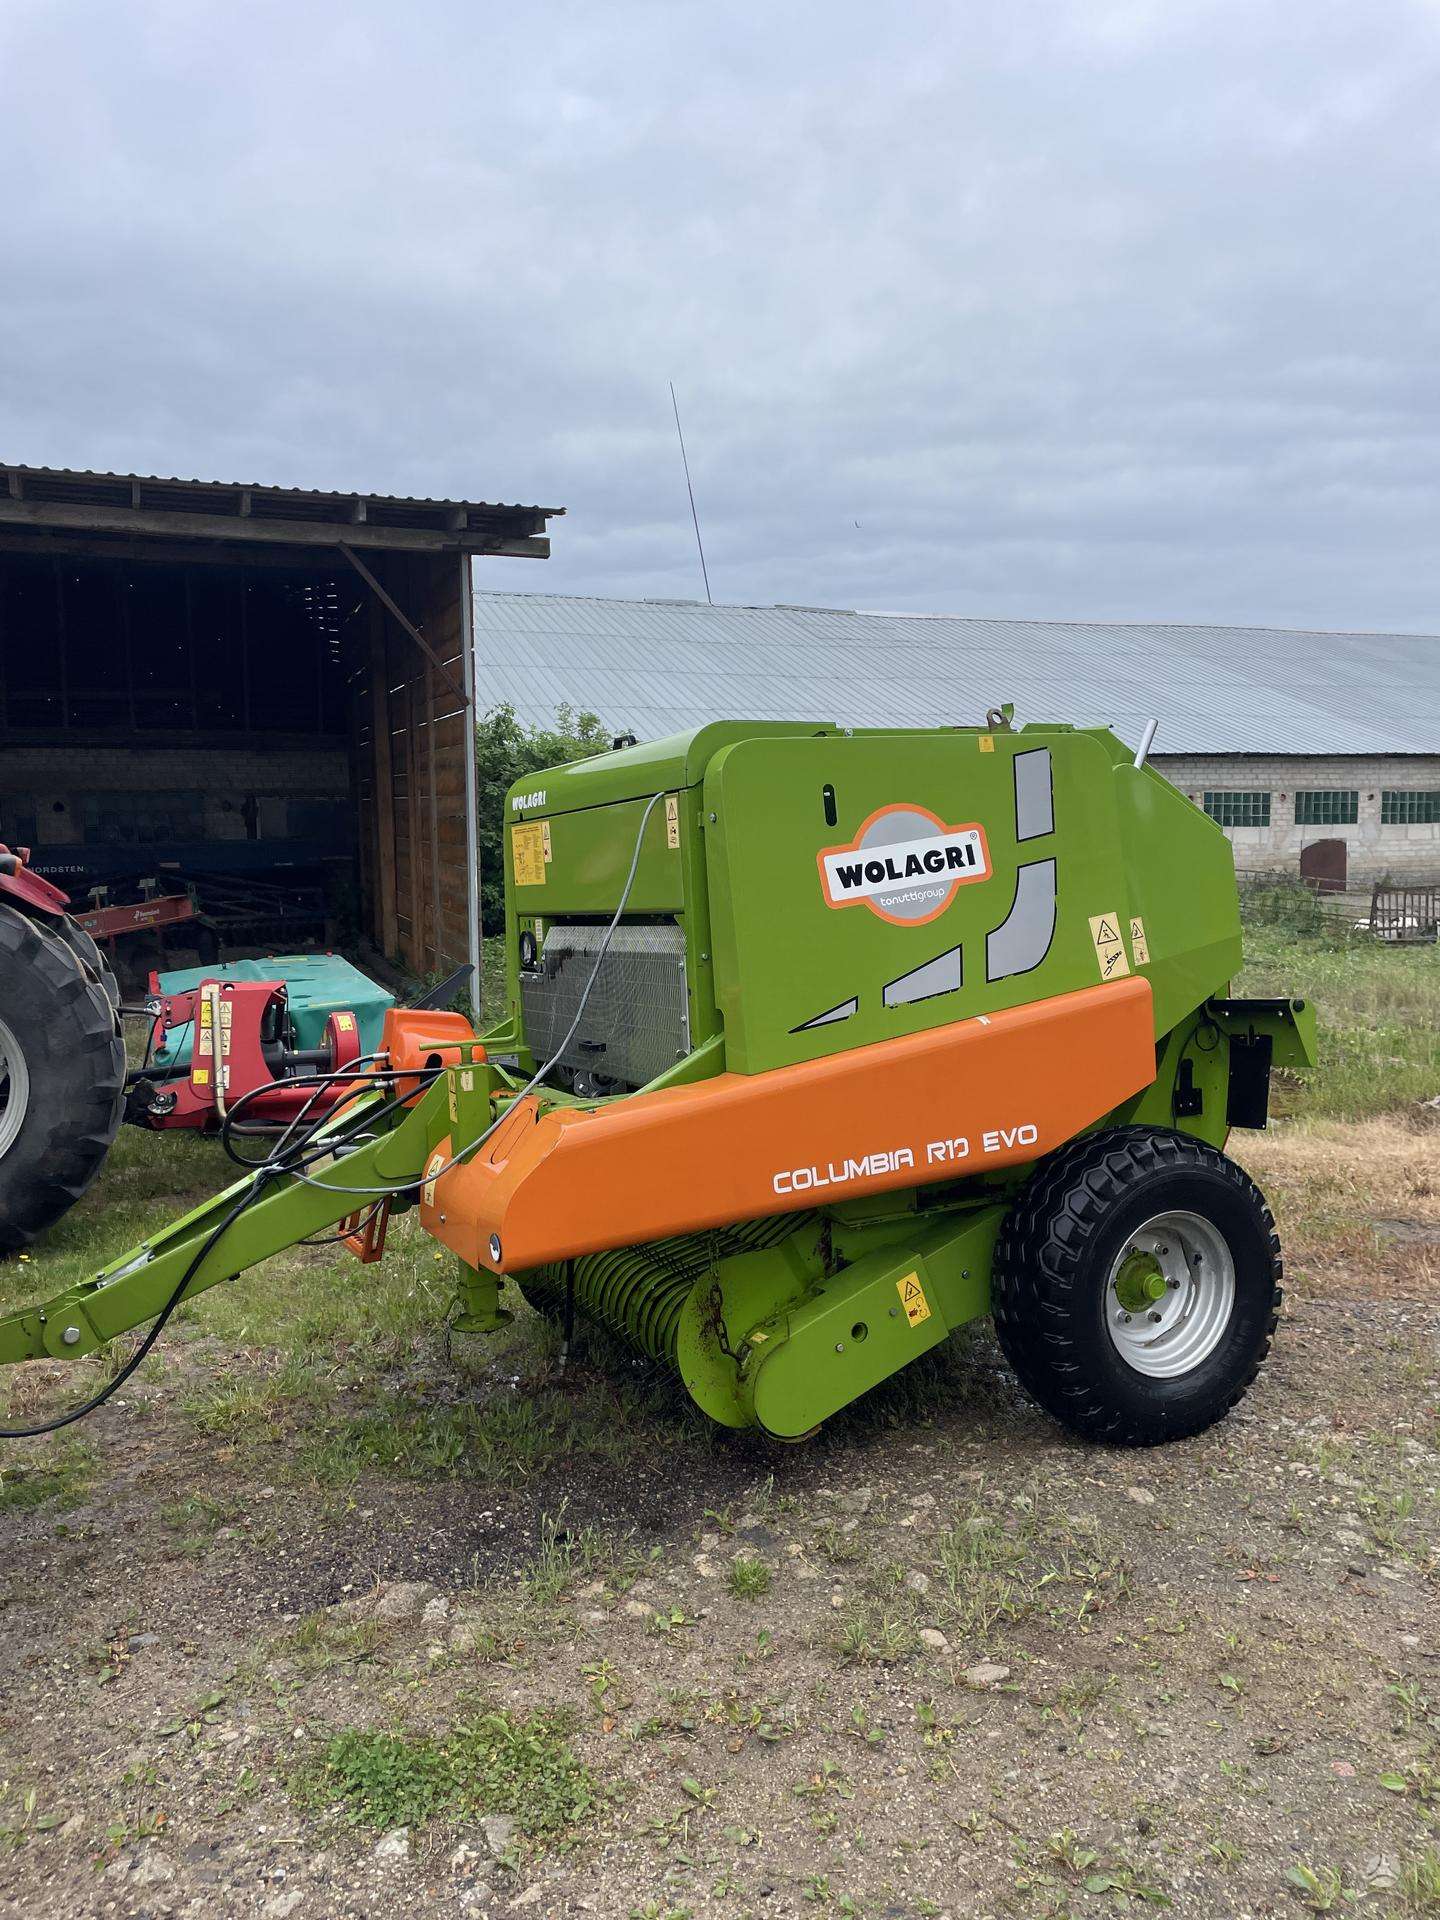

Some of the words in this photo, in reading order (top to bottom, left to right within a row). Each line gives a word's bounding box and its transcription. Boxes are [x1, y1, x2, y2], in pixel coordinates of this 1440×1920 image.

[512, 791, 547, 810] WOLAGRI
[836, 844, 976, 889] WOLAGRI
[773, 1148, 914, 1194] COLUMBIA
[926, 1137, 969, 1164] R10
[982, 1124, 1038, 1153] EVO
